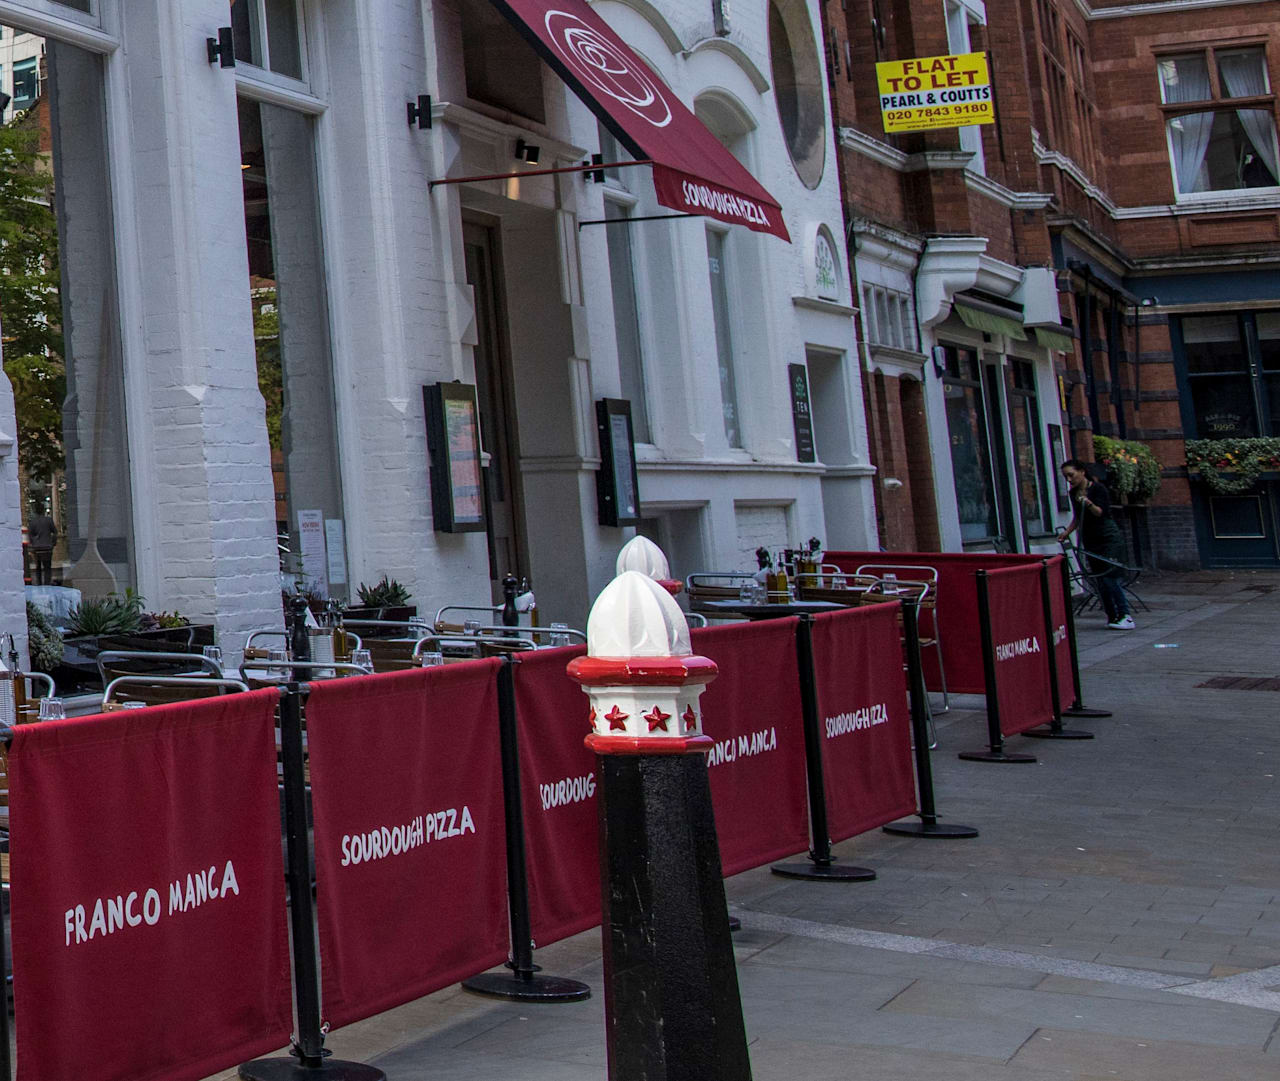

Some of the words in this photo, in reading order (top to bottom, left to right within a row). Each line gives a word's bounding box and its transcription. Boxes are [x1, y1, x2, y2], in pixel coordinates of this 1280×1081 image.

[887, 76, 922, 93] TO
[931, 70, 979, 89] LET
[902, 57, 958, 76] FLAT
[881, 93, 923, 111] PEARL
[927, 92, 937, 105] &
[940, 87, 990, 104] COUTTS
[887, 110, 912, 121] 020
[917, 106, 950, 118] 7843
[954, 103, 988, 115] 9180
[682, 180, 741, 217] SOURDOUGH
[825, 707, 870, 739] SOURDOUGH
[738, 727, 777, 758] MANCA
[539, 772, 597, 811] SOURDOUG
[341, 815, 424, 867] SOURDOUGH
[425, 806, 476, 844] PIZZA
[65, 888, 161, 947] FRANCO
[168, 860, 240, 918] MANCA
